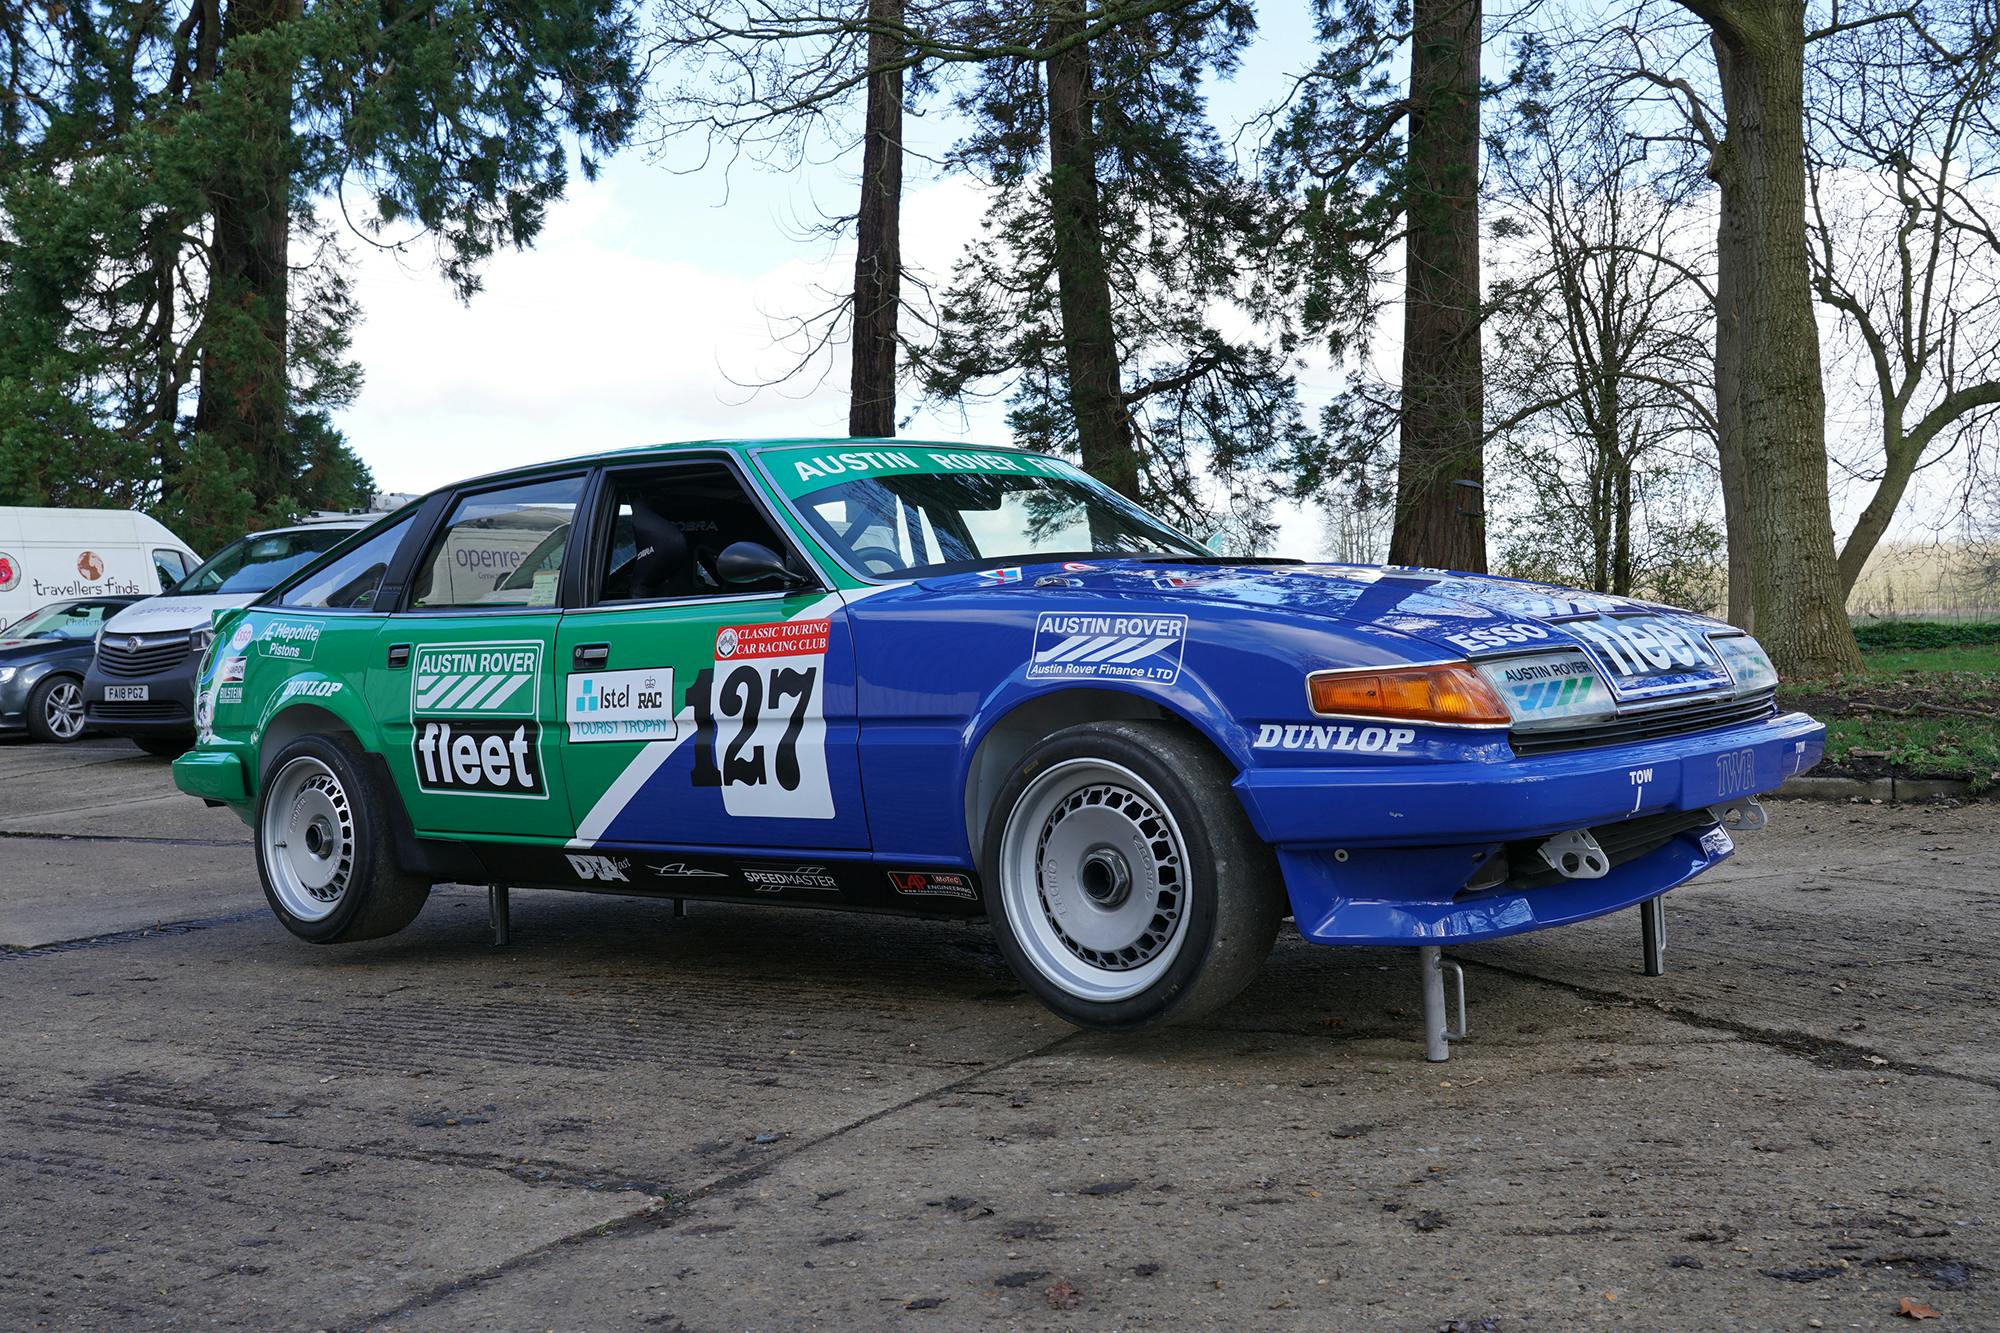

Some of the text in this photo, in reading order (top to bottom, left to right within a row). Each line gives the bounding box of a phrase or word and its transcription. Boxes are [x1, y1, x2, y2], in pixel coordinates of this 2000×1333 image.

[794, 452, 919, 482] AUSTIN
[928, 453, 1025, 472] ROVER
[33, 577, 140, 596] travellers finds
[275, 622, 320, 642] Hepolite
[738, 622, 828, 640] CLASSIC TOURING
[1039, 616, 1182, 637] AUSTIN ROVER
[736, 643, 757, 655] CAR
[758, 640, 797, 653] RACING
[798, 637, 827, 650] CLUB
[1445, 623, 1549, 652] ESSO
[1568, 616, 1715, 677] fleet
[269, 642, 300, 658] Pistons
[419, 652, 535, 673] AUSTIN ROVER
[1031, 663, 1173, 681] Austin Rover Finance LTD
[1504, 660, 1592, 682] AUSTIN ROVER
[108, 685, 144, 699] FA18 PGZ
[220, 687, 243, 699] BILSTEIN
[282, 680, 343, 697] DUNLOP
[637, 691, 662, 709] RAC
[574, 719, 667, 735] TOURIST TROPHY
[685, 665, 817, 791] 127
[1253, 724, 1415, 753] DUNLOP
[418, 722, 534, 788] fleet
[1629, 768, 1653, 785] TOW
[1716, 748, 1756, 797] TWR
[744, 871, 837, 887] SPEEDMASTER
